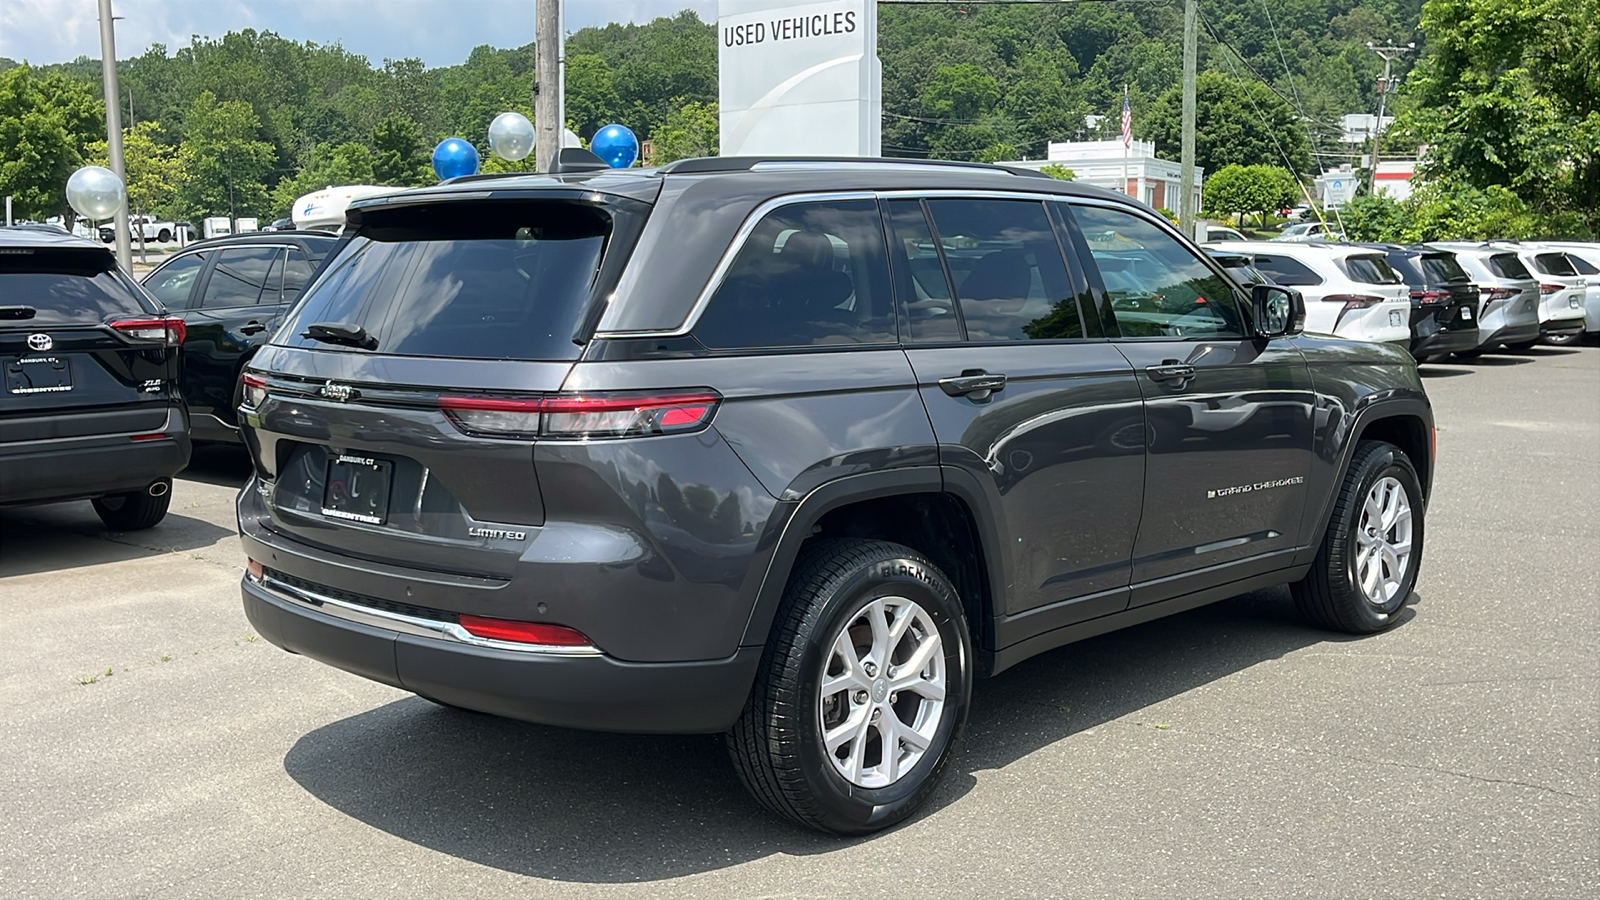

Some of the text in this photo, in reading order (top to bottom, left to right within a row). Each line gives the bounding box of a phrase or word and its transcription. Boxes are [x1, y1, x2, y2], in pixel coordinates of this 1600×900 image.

[724, 11, 857, 48] USED VEHICLES
[366, 458, 375, 466] CT
[1216, 476, 1304, 497] GRAND CHEROKEE
[468, 526, 527, 541] LIMITED
